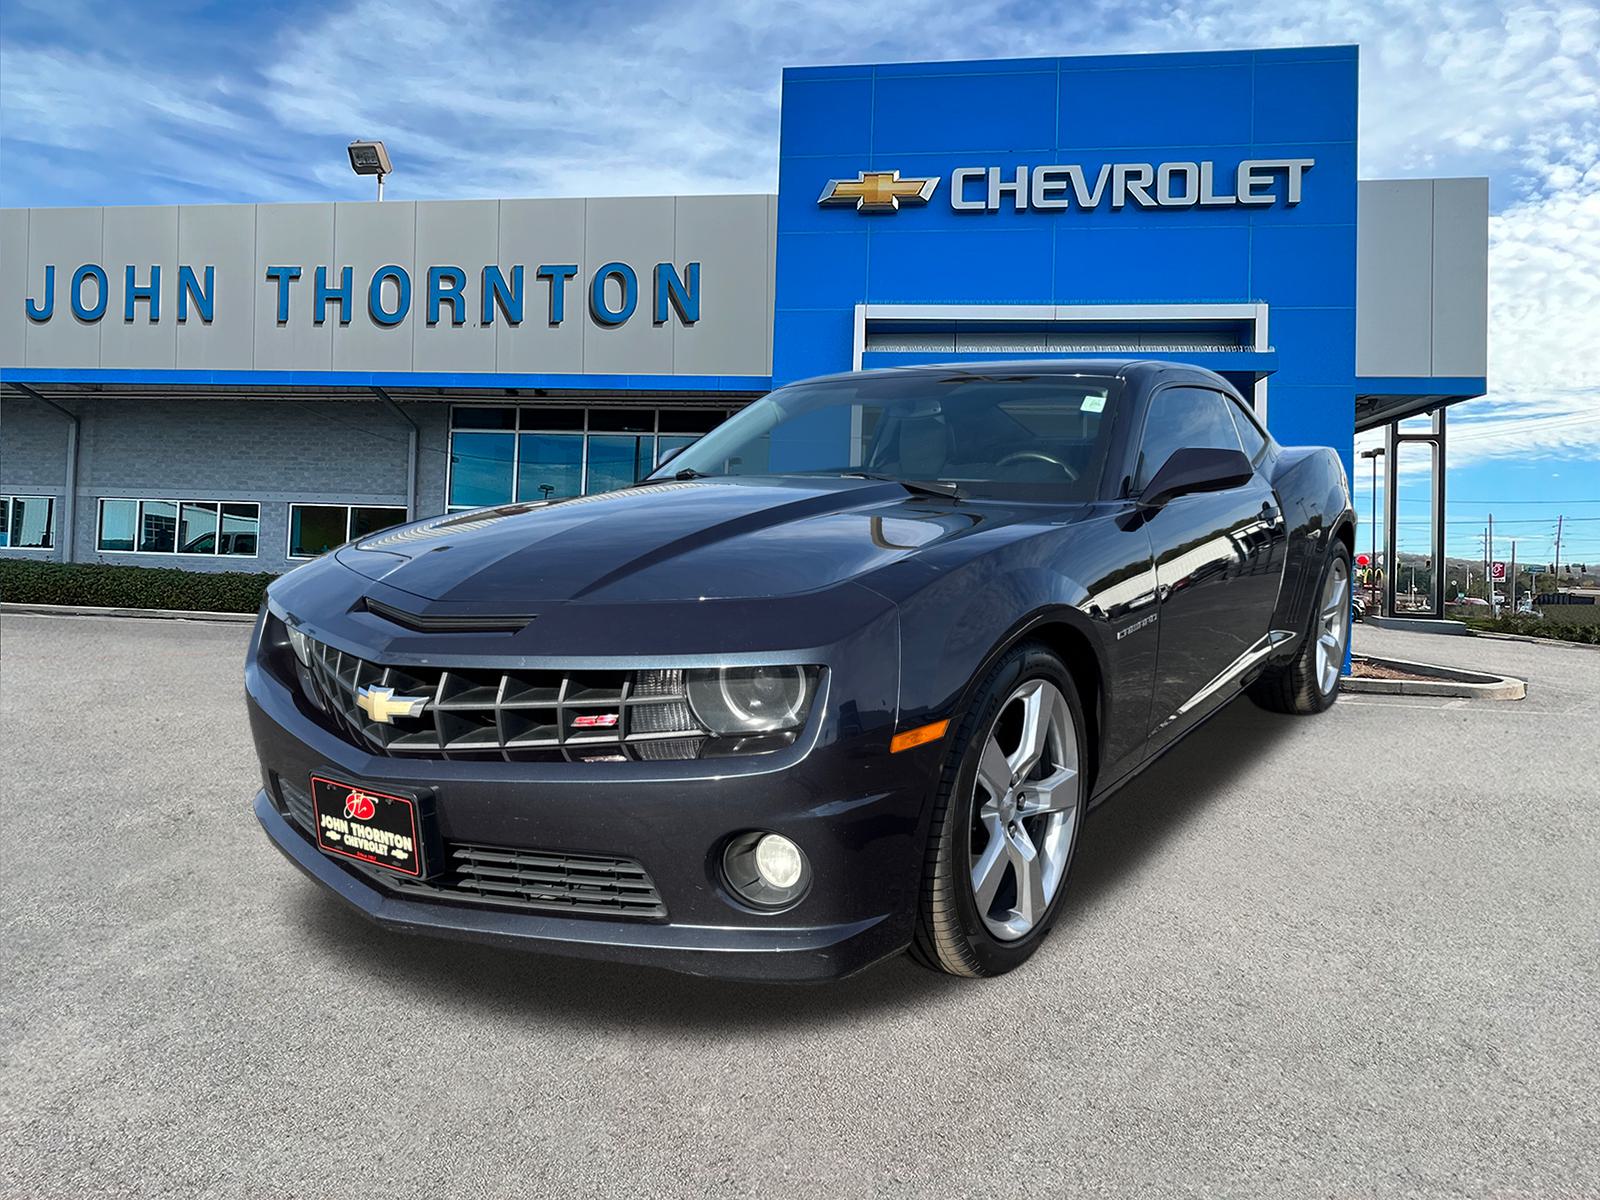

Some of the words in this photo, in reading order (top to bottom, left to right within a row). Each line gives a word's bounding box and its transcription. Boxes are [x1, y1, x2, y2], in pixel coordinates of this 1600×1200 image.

[951, 158, 1316, 211] CHEVROLET
[25, 264, 215, 323] JOHN
[266, 261, 701, 326] THORNTON
[321, 814, 349, 833] JOHN
[350, 822, 413, 852] THORNTON
[343, 834, 388, 856] CHEVROLET
